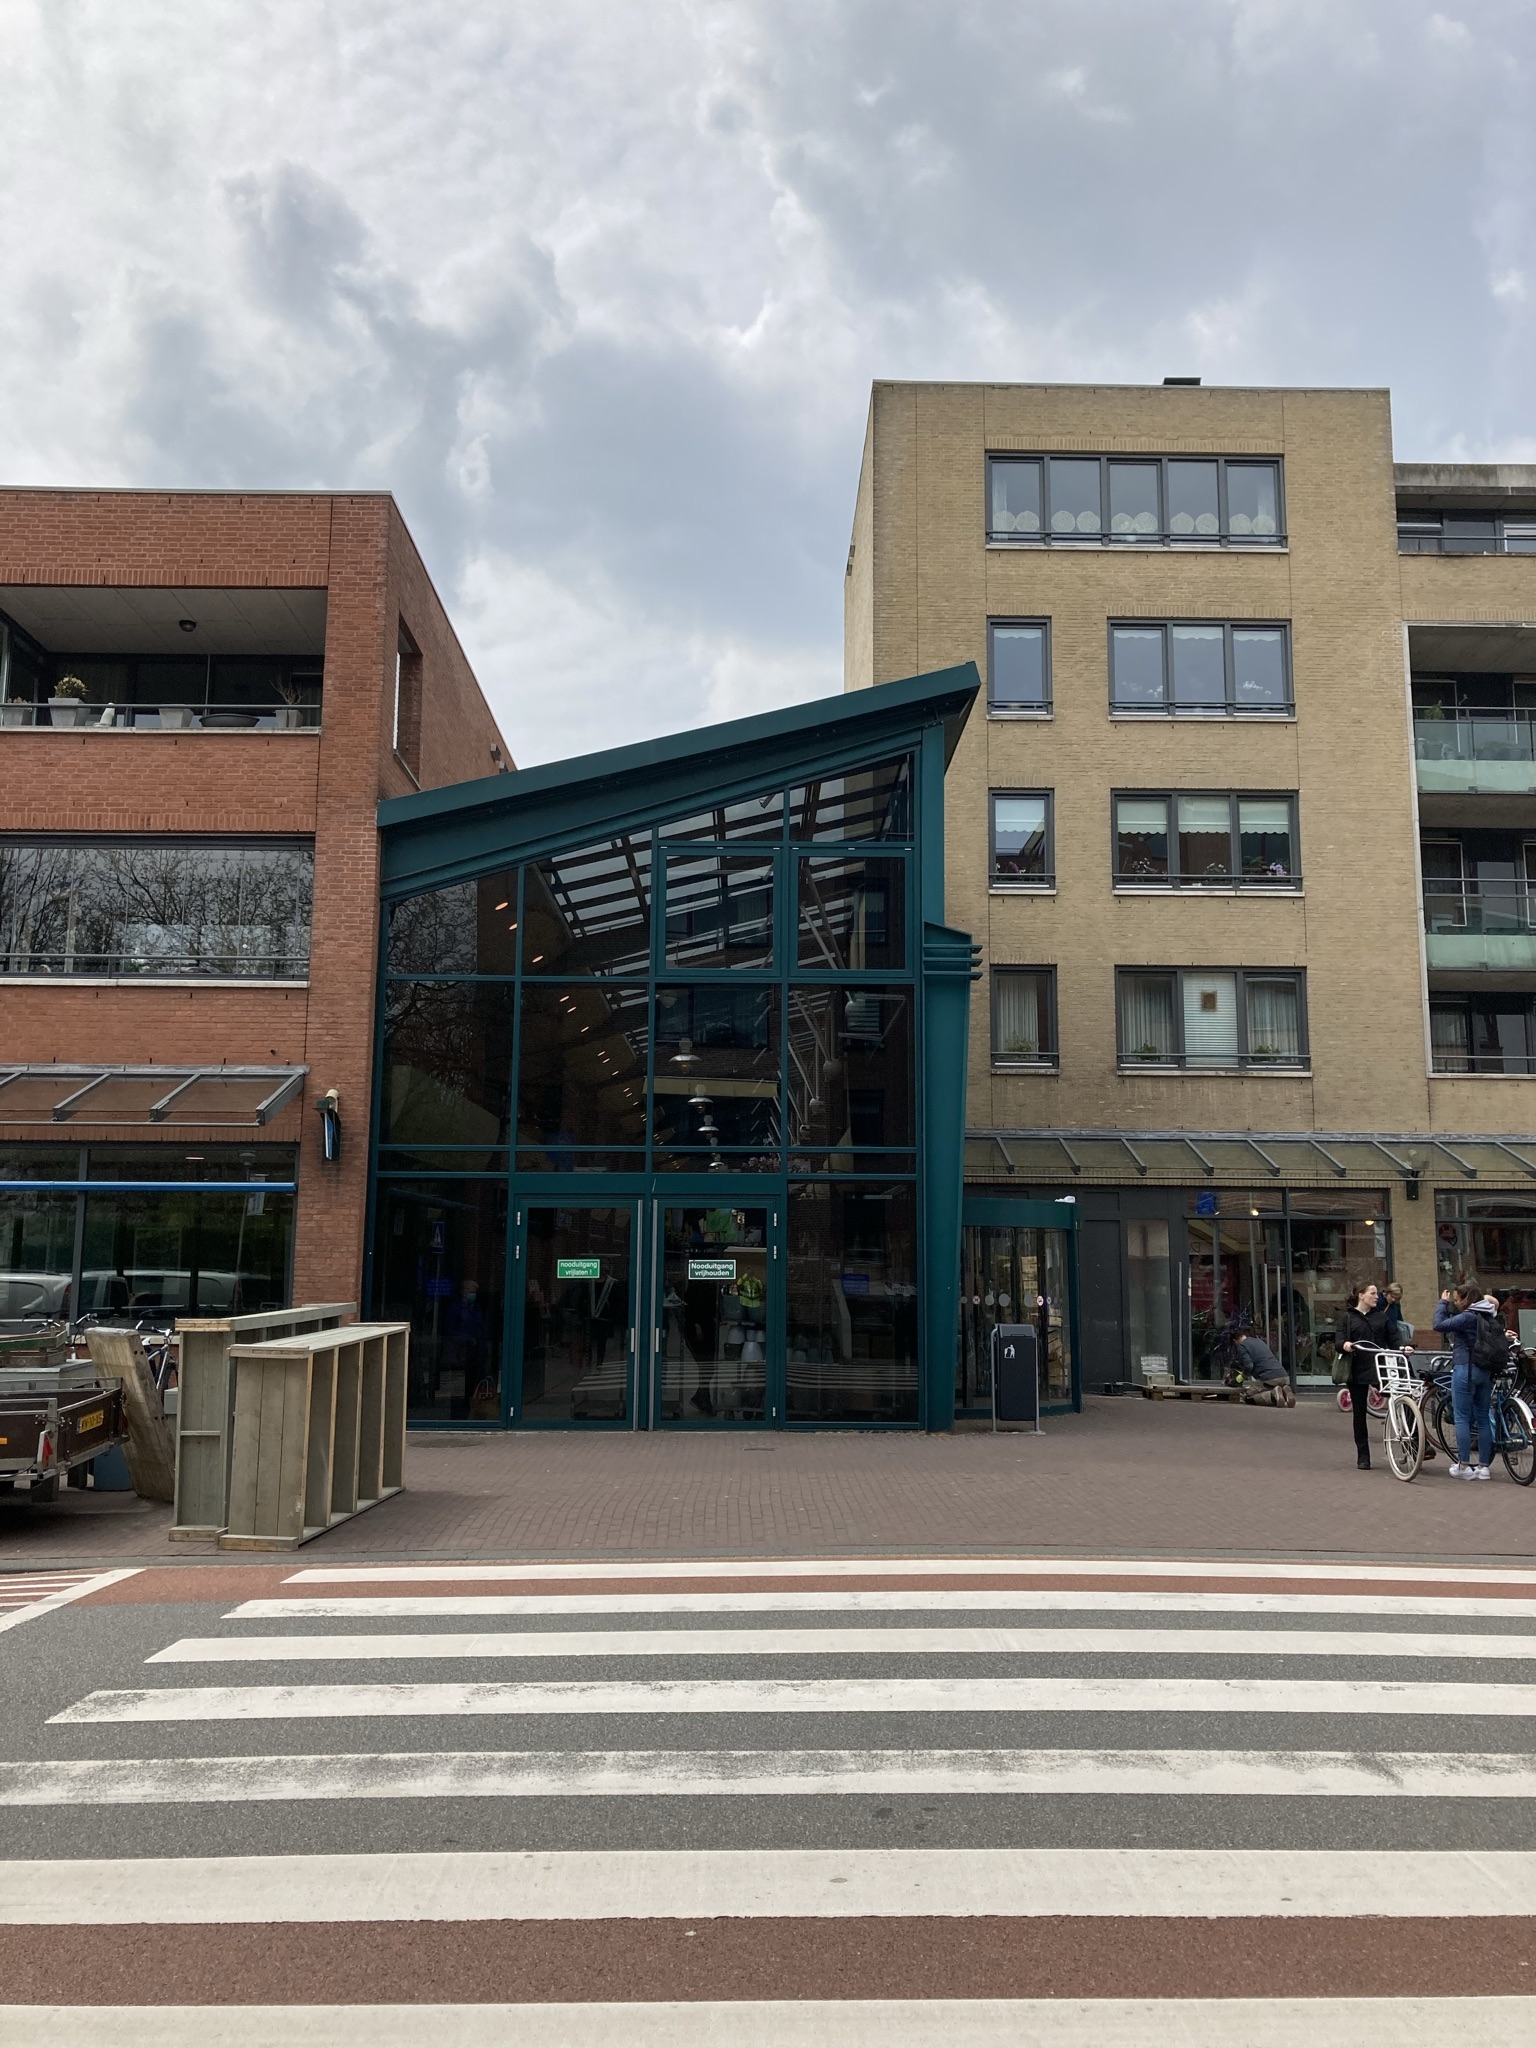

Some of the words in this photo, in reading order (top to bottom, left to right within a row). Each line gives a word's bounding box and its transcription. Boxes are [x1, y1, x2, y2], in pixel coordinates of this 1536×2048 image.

[560, 1261, 598, 1269] nooduitgang
[691, 1262, 734, 1271] Nooduitgang
[565, 1269, 589, 1277] vrijlaten
